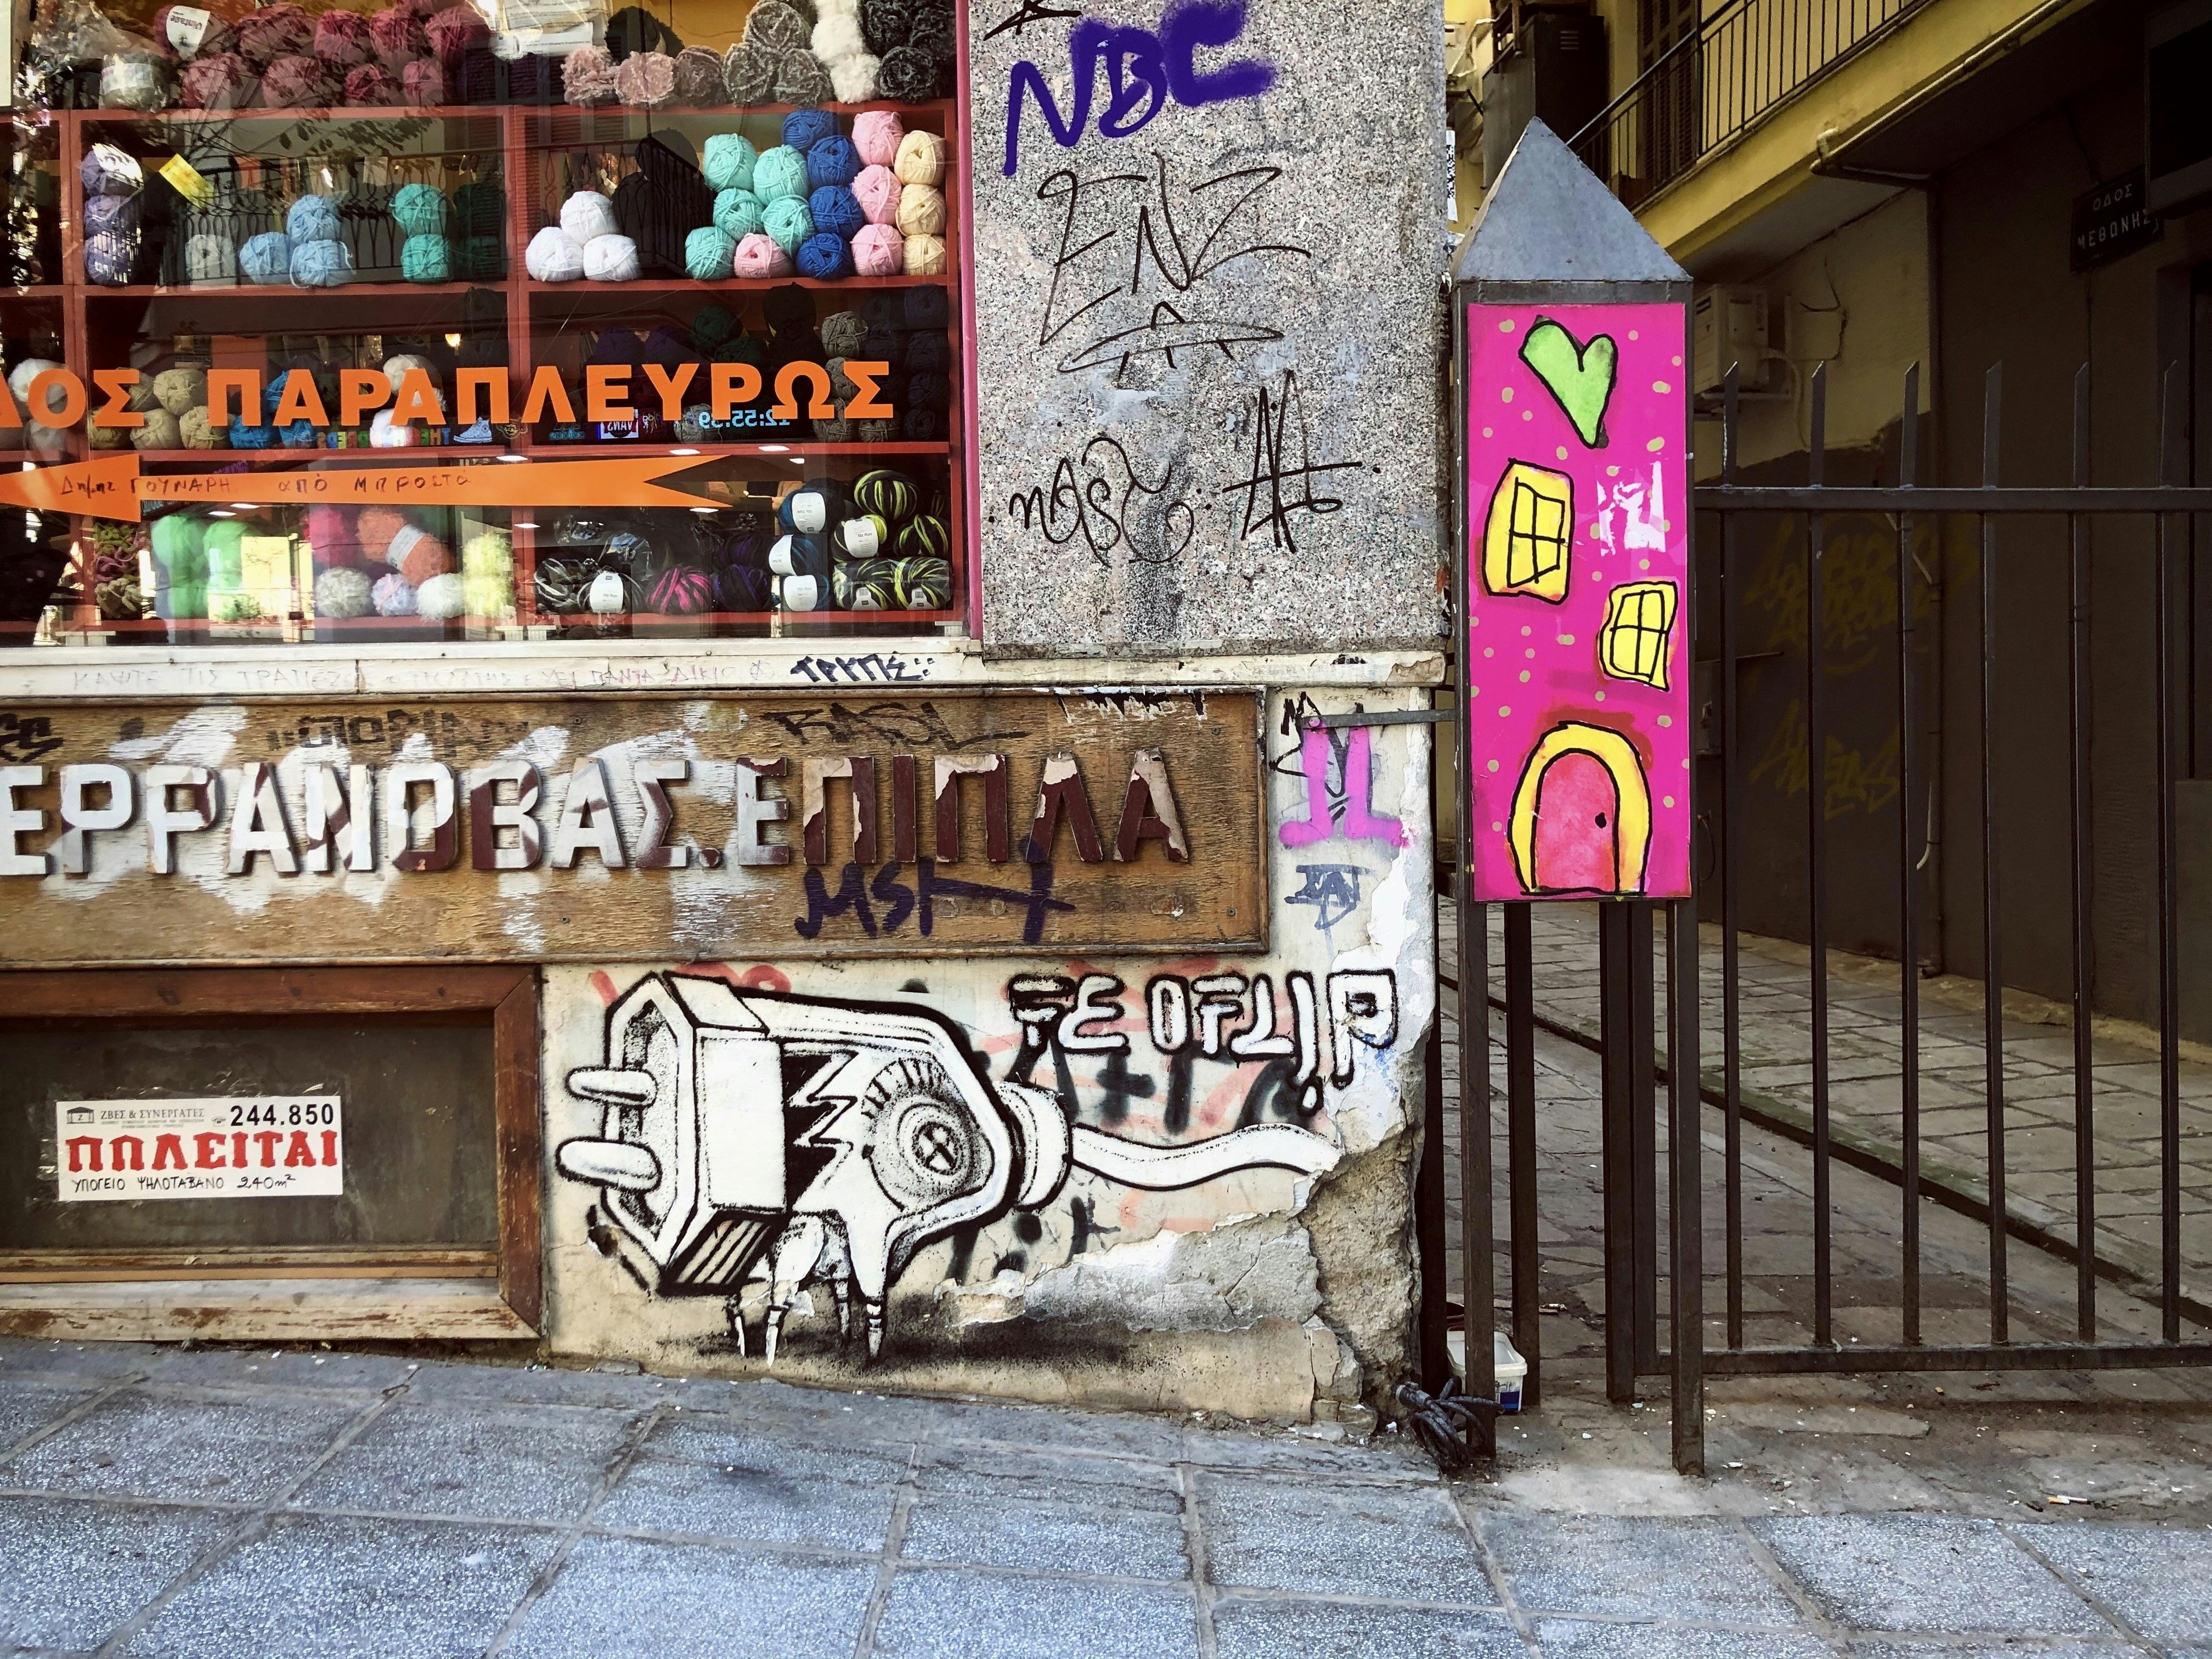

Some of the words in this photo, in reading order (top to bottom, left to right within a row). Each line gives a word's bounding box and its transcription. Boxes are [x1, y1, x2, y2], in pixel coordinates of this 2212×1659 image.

[2093, 183, 2132, 211] ΟΔΟΣ
[207, 360, 894, 426] ΠΑΡΑΠΛΕΥΡΩΣ
[130, 477, 230, 495] ΓΟΥΝΑΡΗ
[736, 747, 1189, 865] ΕΠΙΠΛΑ
[100, 1110, 126, 1119] ΖΒΕΣ
[129, 1110, 137, 1119] &
[140, 1108, 205, 1119] ΣΥΝΕΡΓΑΤΕΣ
[230, 1103, 334, 1126] 244.850
[65, 1129, 337, 1172] ΠΩΛΕΙΤΑΙ
[72, 1177, 126, 1192] ΥΠΟΓΕΙΟ
[137, 1176, 224, 1190] ΨΗΛΟΤΑΒΑΝΟ
